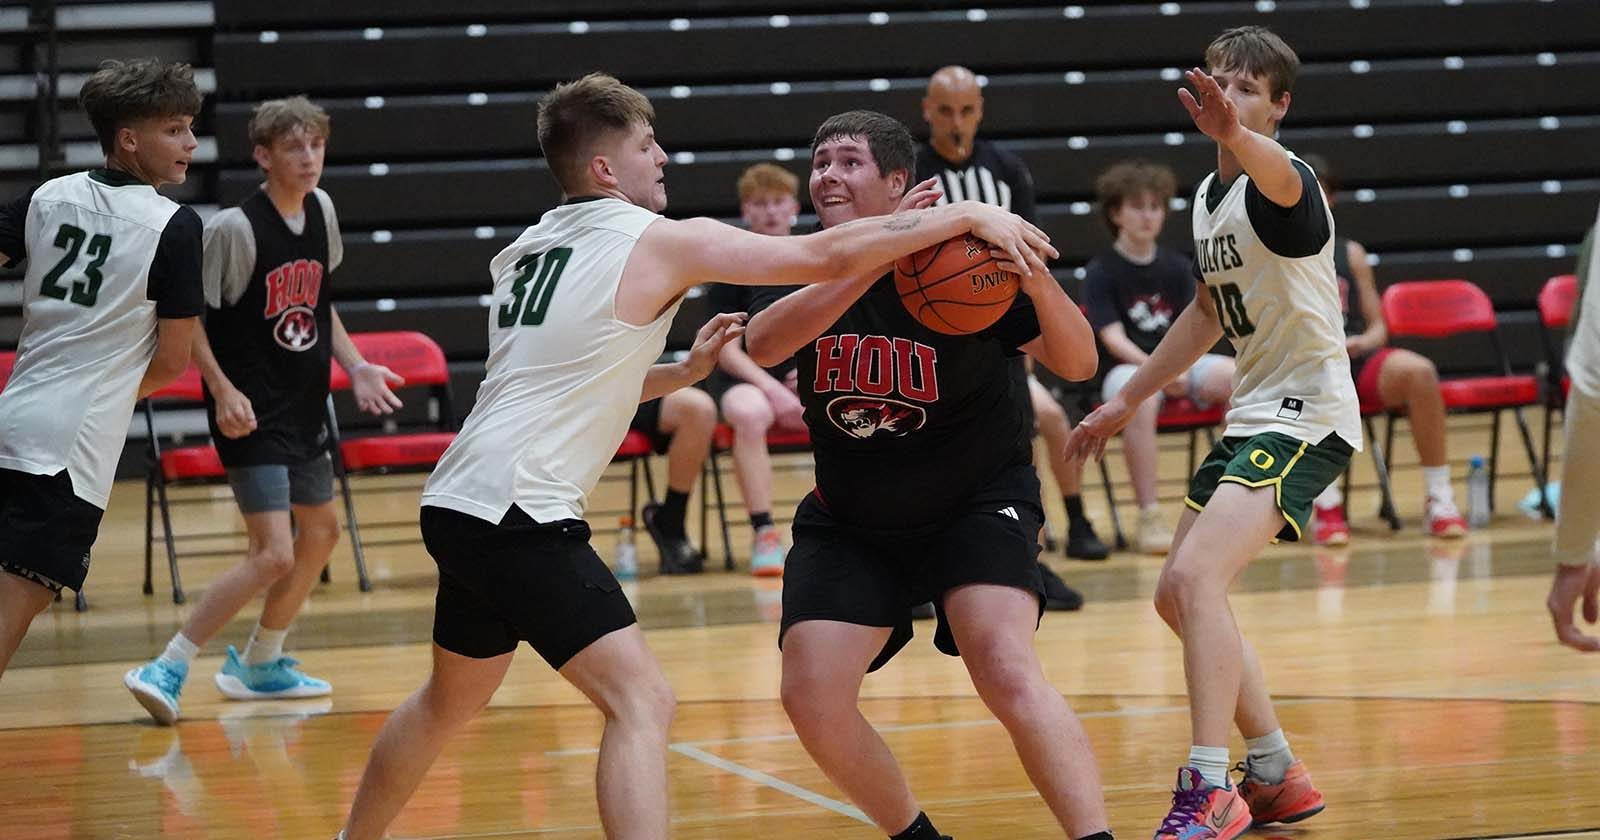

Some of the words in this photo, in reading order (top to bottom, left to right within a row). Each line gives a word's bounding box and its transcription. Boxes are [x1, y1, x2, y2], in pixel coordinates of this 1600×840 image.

[39, 224, 112, 308] 23
[971, 270, 1017, 295] DING
[1198, 233, 1243, 273] OLVES
[264, 259, 323, 320] HOU
[498, 247, 573, 328] 30
[813, 334, 939, 403] HOU
[1287, 400, 1297, 409] M
